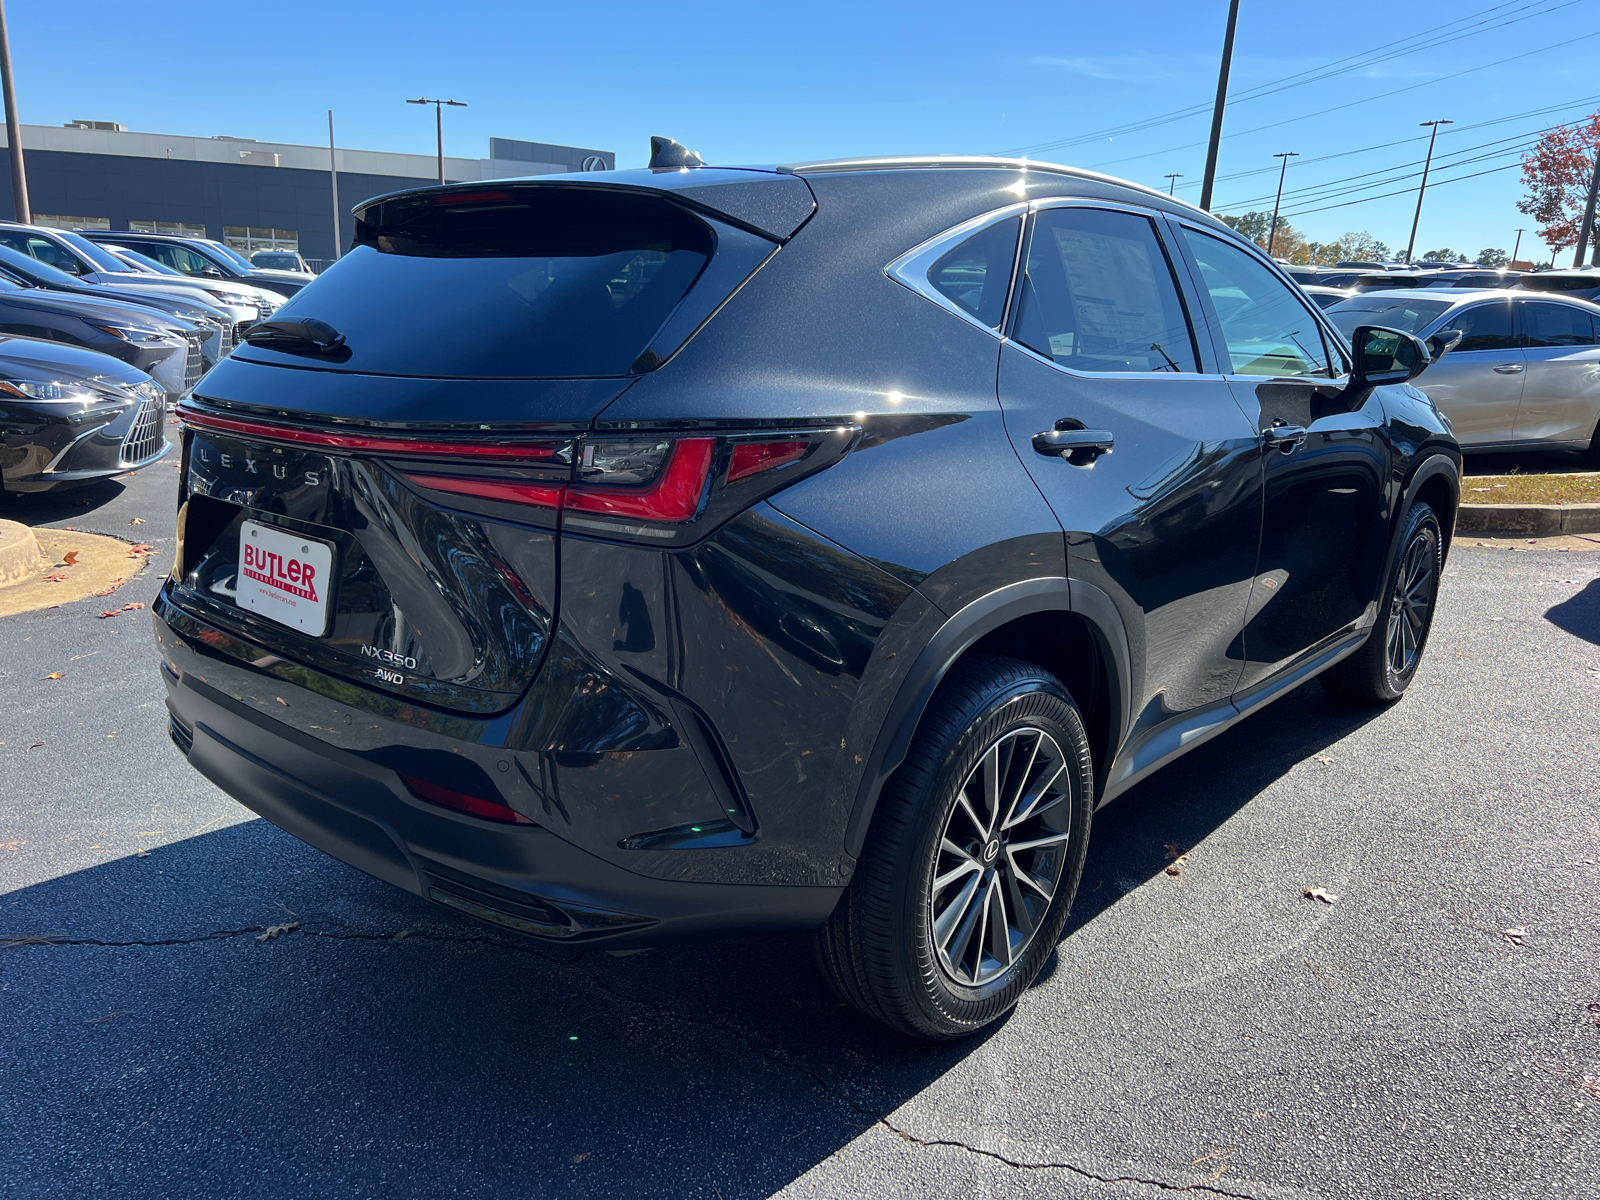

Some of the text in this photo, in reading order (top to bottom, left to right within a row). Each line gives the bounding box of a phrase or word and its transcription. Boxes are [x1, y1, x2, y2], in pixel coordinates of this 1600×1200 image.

[200, 448, 320, 486] LEXUS
[361, 643, 417, 669] NX350
[374, 668, 404, 685] AWD
